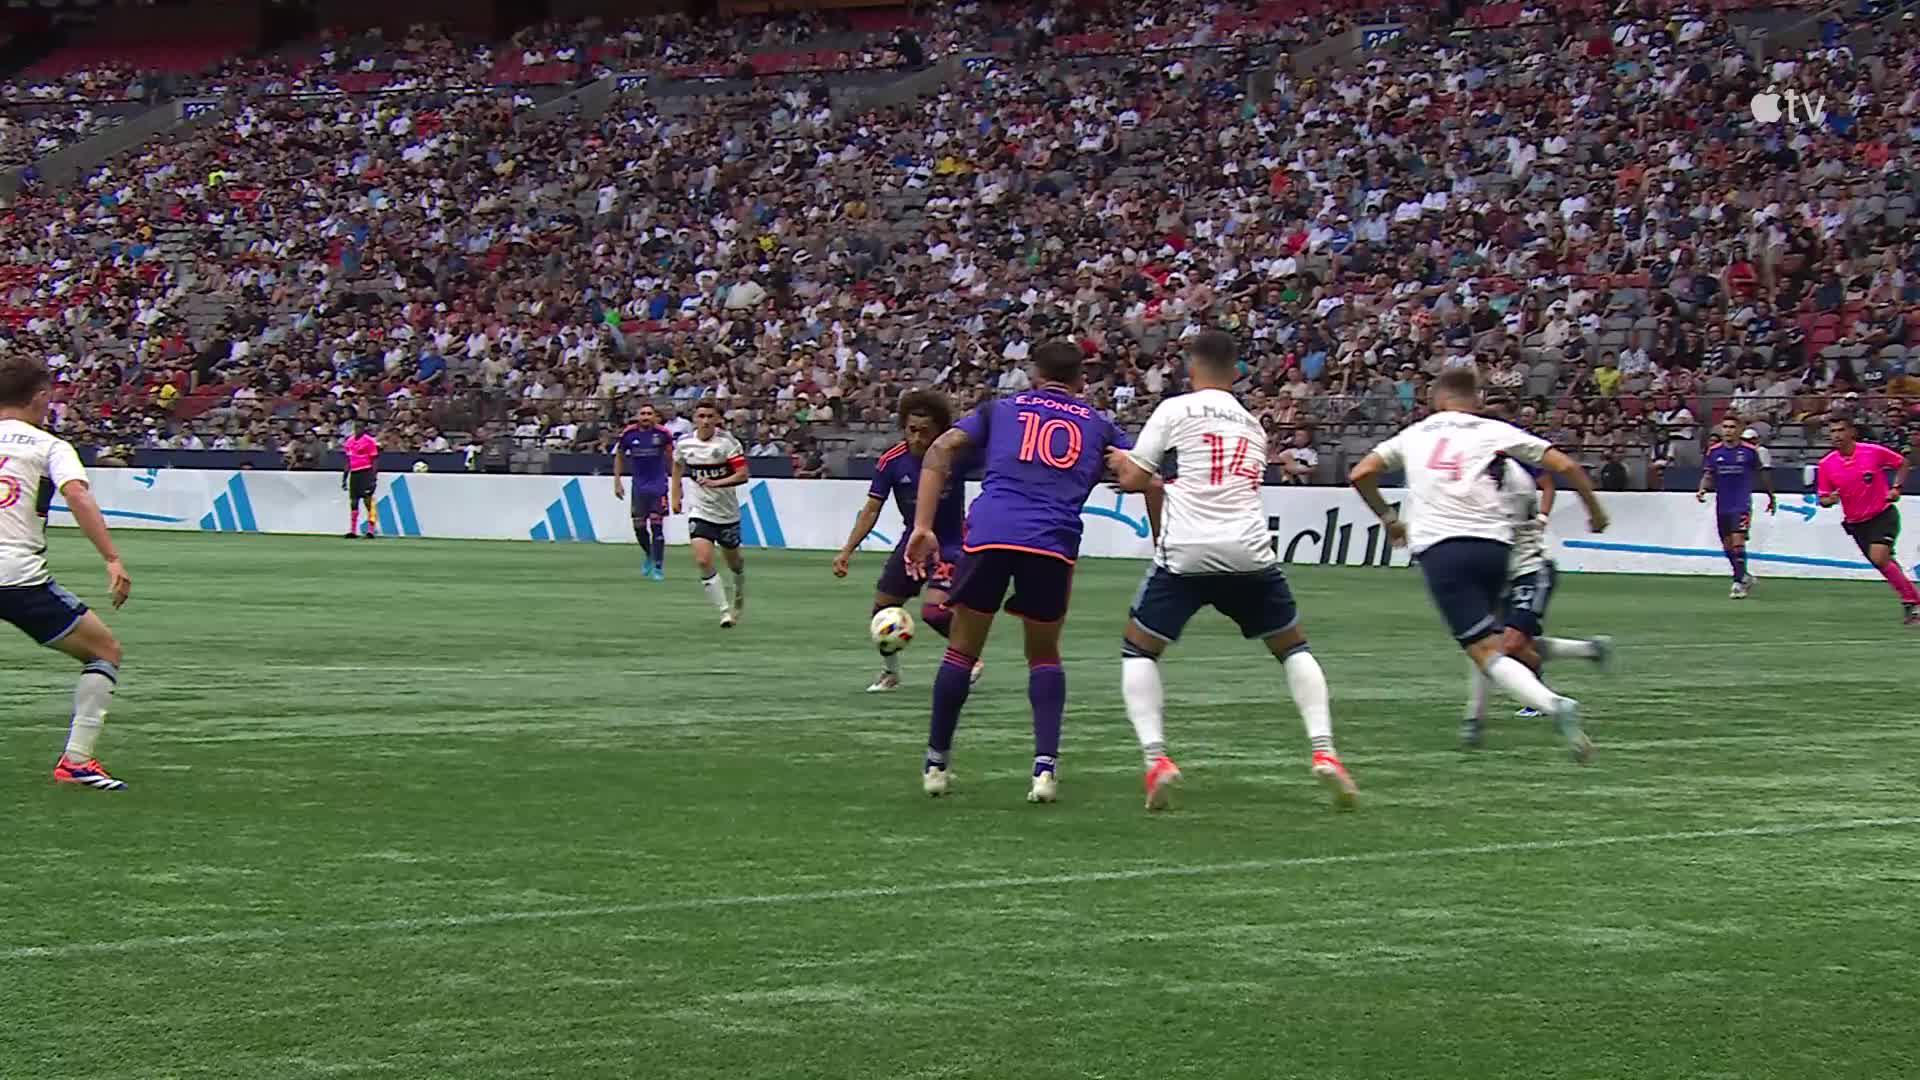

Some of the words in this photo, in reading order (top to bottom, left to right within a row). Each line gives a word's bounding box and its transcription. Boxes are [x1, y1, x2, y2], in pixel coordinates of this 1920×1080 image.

[1015, 395, 1091, 420] E.PONCE
[1017, 411, 1083, 469] 10
[1202, 432, 1260, 496] 14
[1423, 437, 1465, 481] 4
